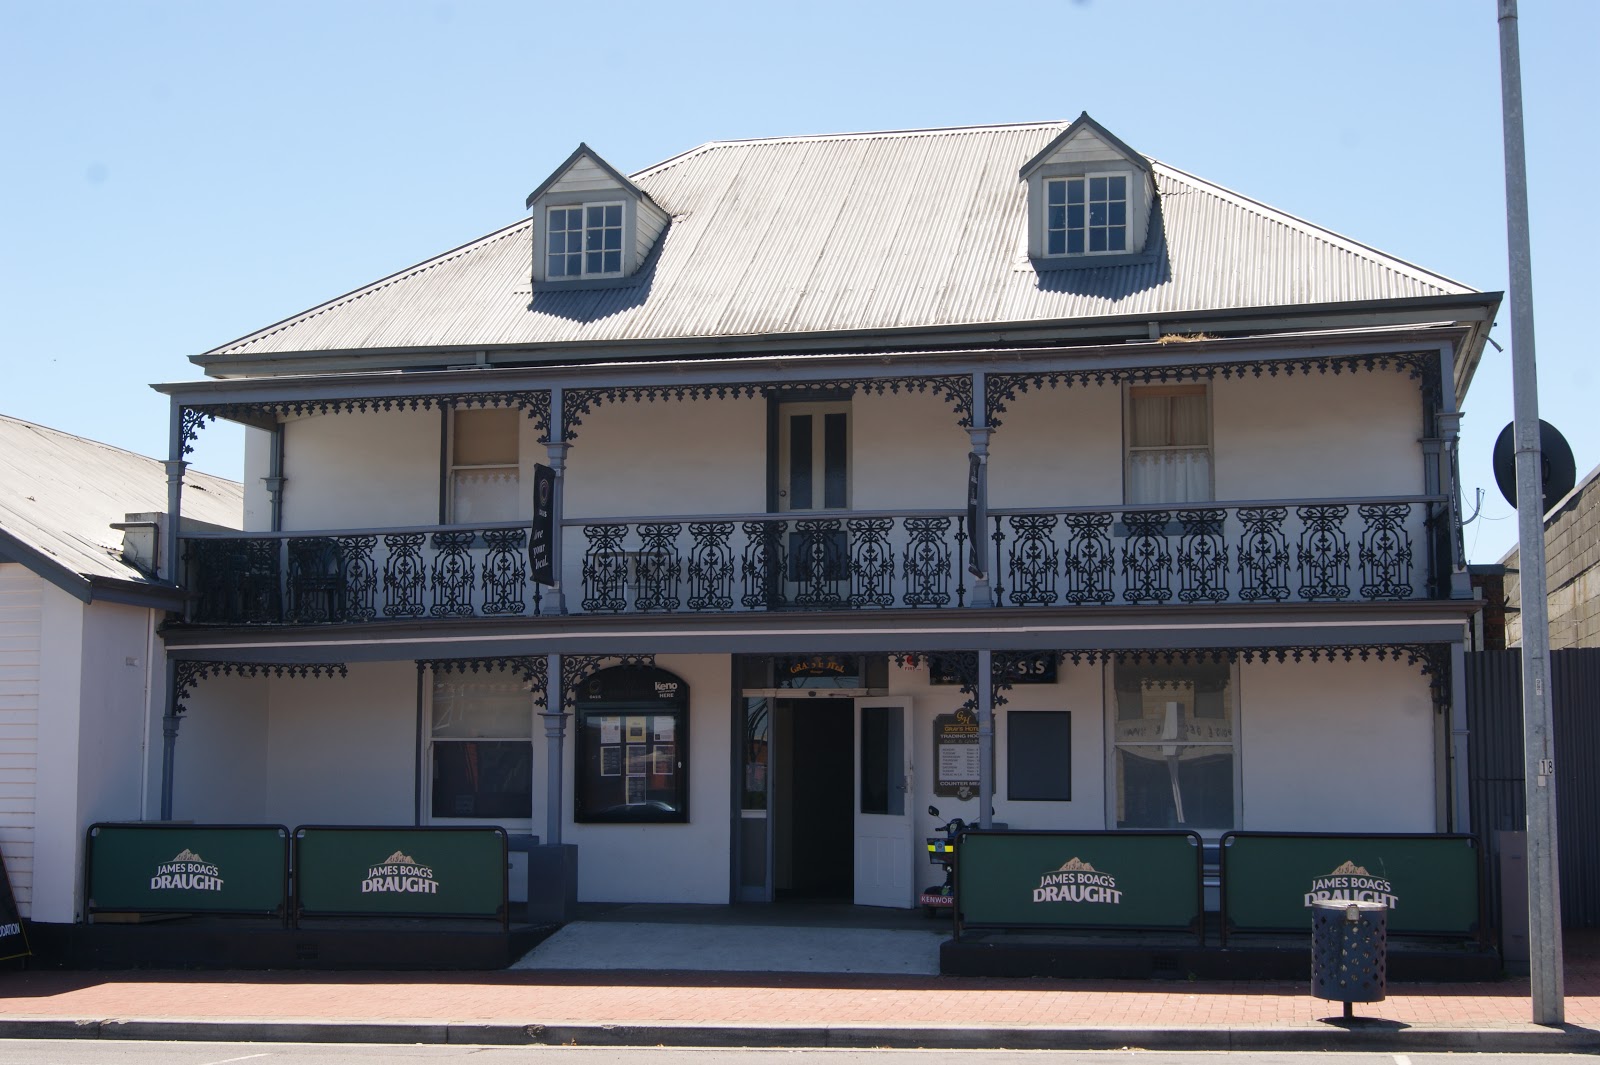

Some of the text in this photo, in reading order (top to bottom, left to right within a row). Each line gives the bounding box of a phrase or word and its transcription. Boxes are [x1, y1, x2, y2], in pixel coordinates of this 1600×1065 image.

[156, 863, 219, 877] JAMES BOAG'S
[367, 865, 433, 879] JAMES BOAG'S
[150, 873, 224, 892] DRAUGHT
[361, 876, 439, 894] DRAUGHT
[1040, 873, 1116, 888] JAMES BOAG'S
[1311, 877, 1391, 892] JAMES BOAG'S
[920, 895, 954, 904] KENWOR
[1033, 885, 1123, 904] DRAUGHT
